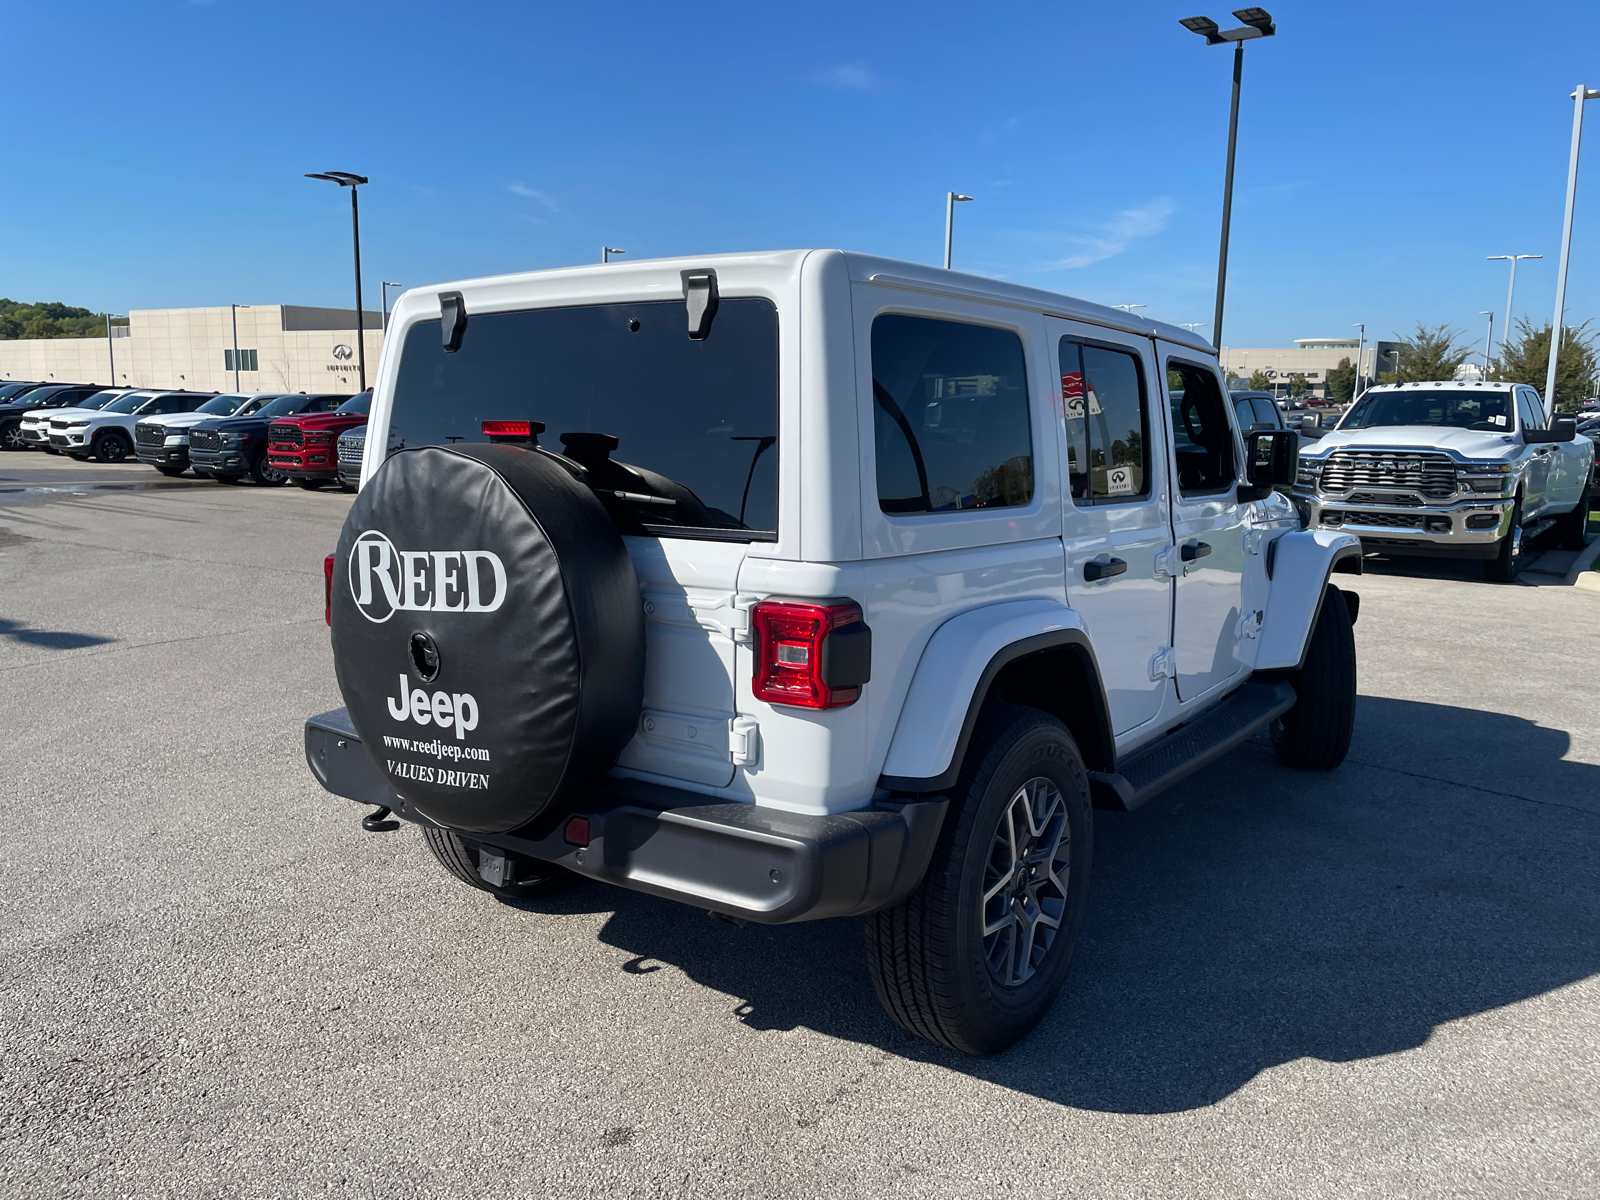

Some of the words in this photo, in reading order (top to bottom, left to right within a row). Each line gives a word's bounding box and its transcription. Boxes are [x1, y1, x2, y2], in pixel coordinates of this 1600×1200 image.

[1354, 459, 1421, 471] RAM
[355, 538, 508, 614] REED
[386, 673, 480, 740] Jeep
[382, 735, 490, 762] www.reedjeep.com
[386, 759, 435, 783] VALUES
[436, 768, 490, 790] DRIVEN
